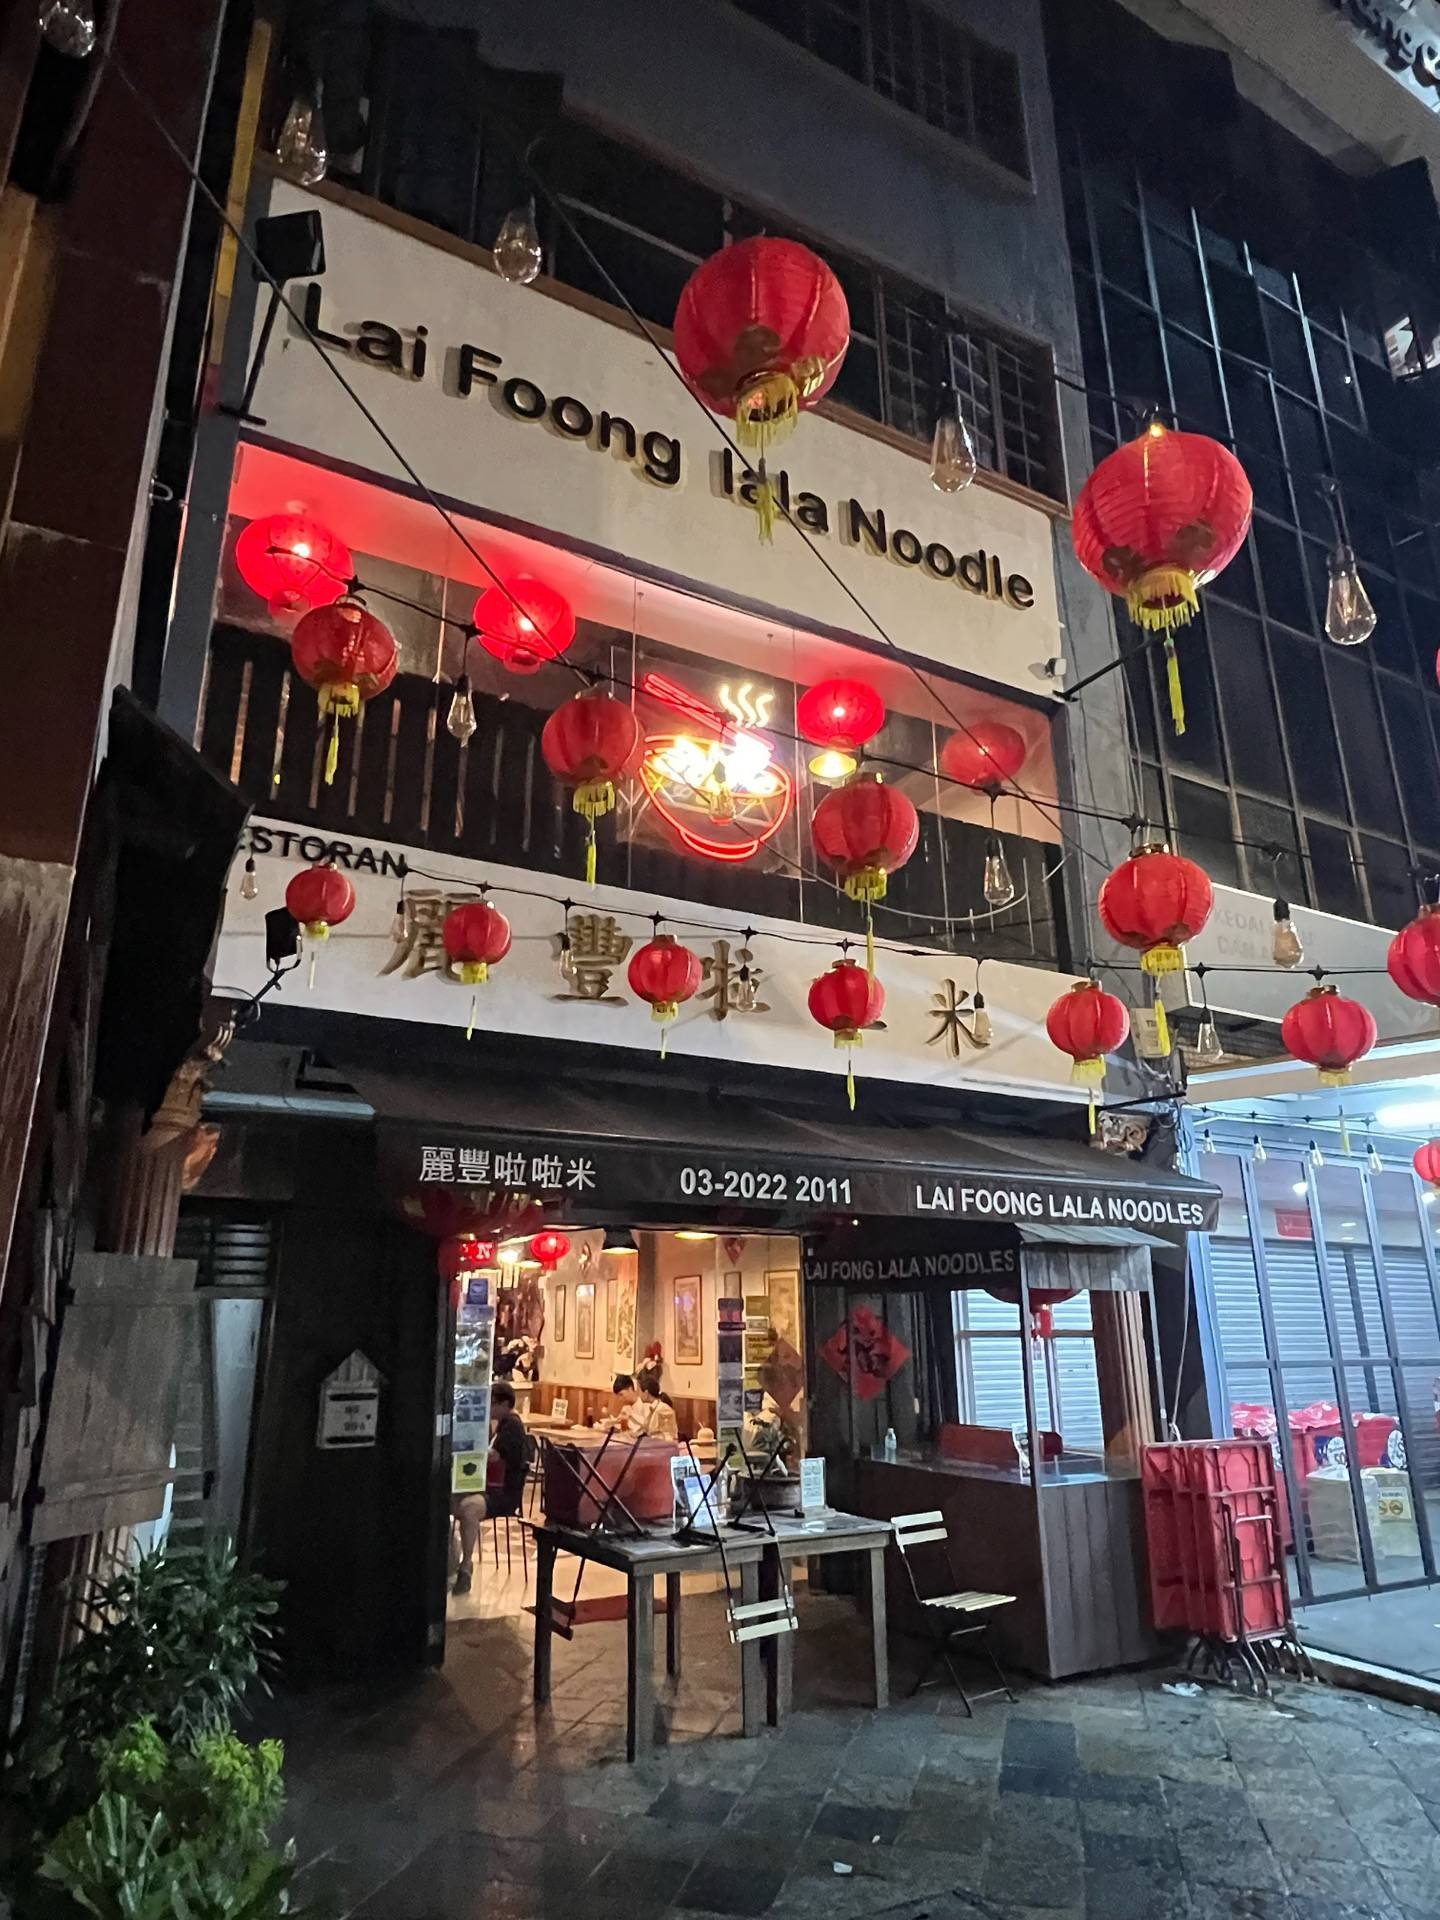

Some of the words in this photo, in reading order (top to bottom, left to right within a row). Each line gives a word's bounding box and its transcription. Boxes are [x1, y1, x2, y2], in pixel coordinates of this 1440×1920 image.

[304, 282, 429, 380] Lai
[458, 343, 682, 486] Foong
[848, 498, 1036, 609] Noodle
[419, 1145, 597, 1191] 麗豐啦啦米
[680, 1167, 788, 1200] 03-2022
[795, 1175, 851, 1204] 2011
[916, 1185, 955, 1211] LAI
[961, 1188, 1044, 1216] FOONG
[1048, 1194, 1105, 1220] LALA
[1108, 1197, 1204, 1225] NOODLES
[805, 1260, 828, 1280] LAI
[831, 1260, 874, 1280] FONG
[878, 1256, 920, 1279] LALA
[924, 1249, 1015, 1277] NOODLES
